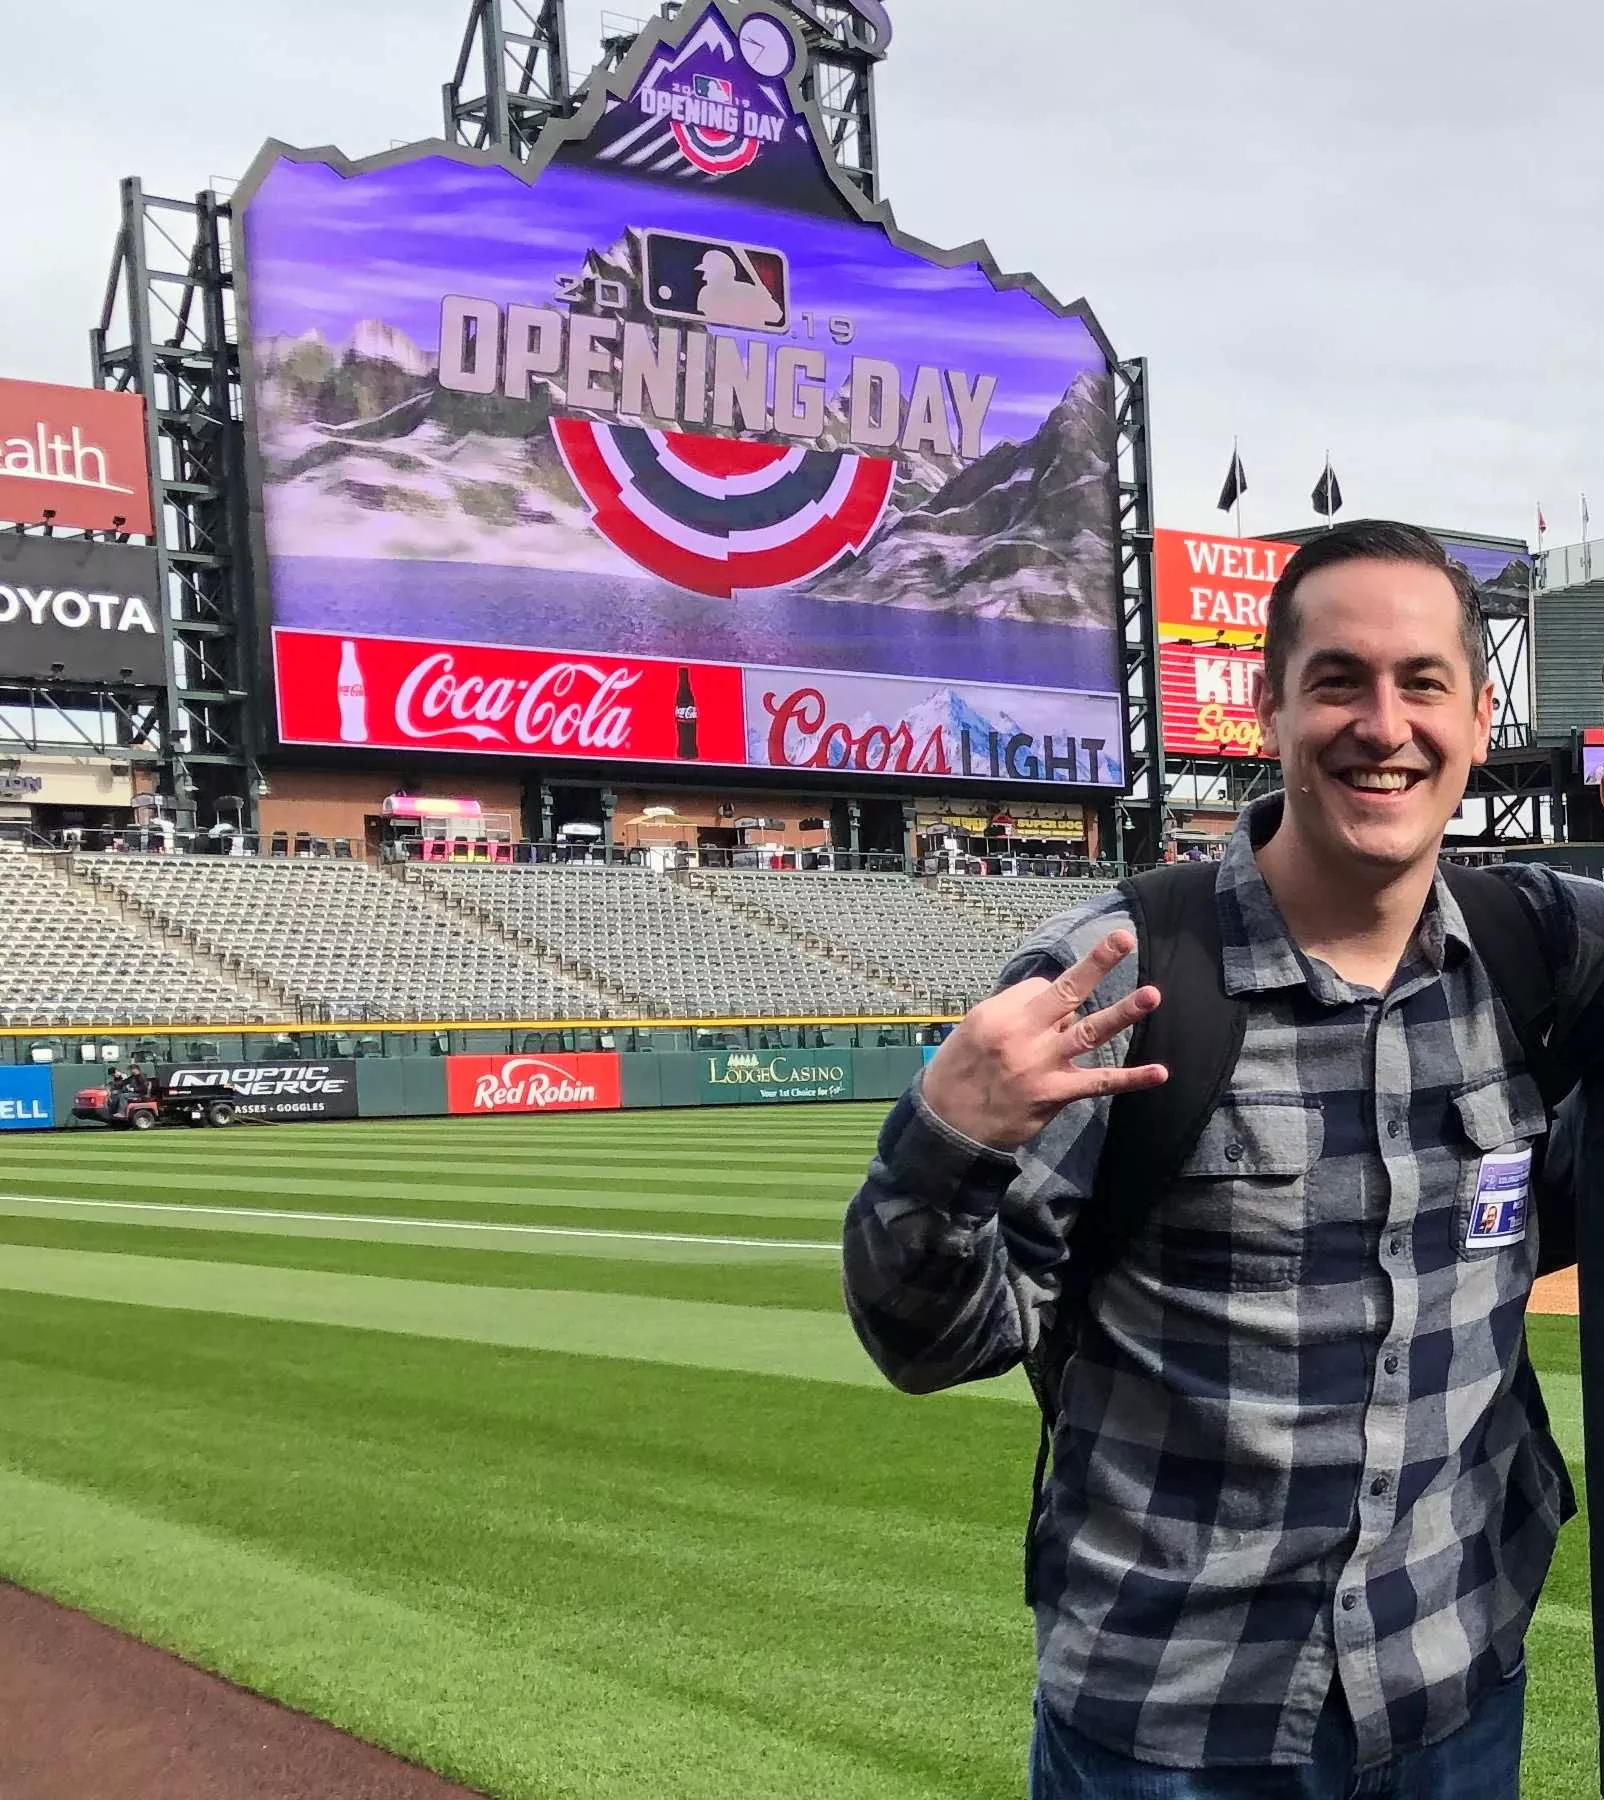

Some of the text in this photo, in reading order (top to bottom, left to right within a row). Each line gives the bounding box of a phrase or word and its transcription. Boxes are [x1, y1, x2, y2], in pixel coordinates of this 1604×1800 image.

[640, 87, 785, 142] OPENING DAY
[553, 272, 857, 345] 20 19
[439, 293, 998, 459] OPENING DAY
[0, 421, 107, 486] alth
[1184, 539, 1296, 582] WELL
[394, 653, 643, 750] Coca-Cola
[762, 687, 1106, 784] Coors LIGHT
[232, 1066, 330, 1082] OPTIC
[232, 1079, 348, 1096] NERVE
[474, 1073, 595, 1109] Red Robin
[276, 1102, 325, 1113] GOGGLES
